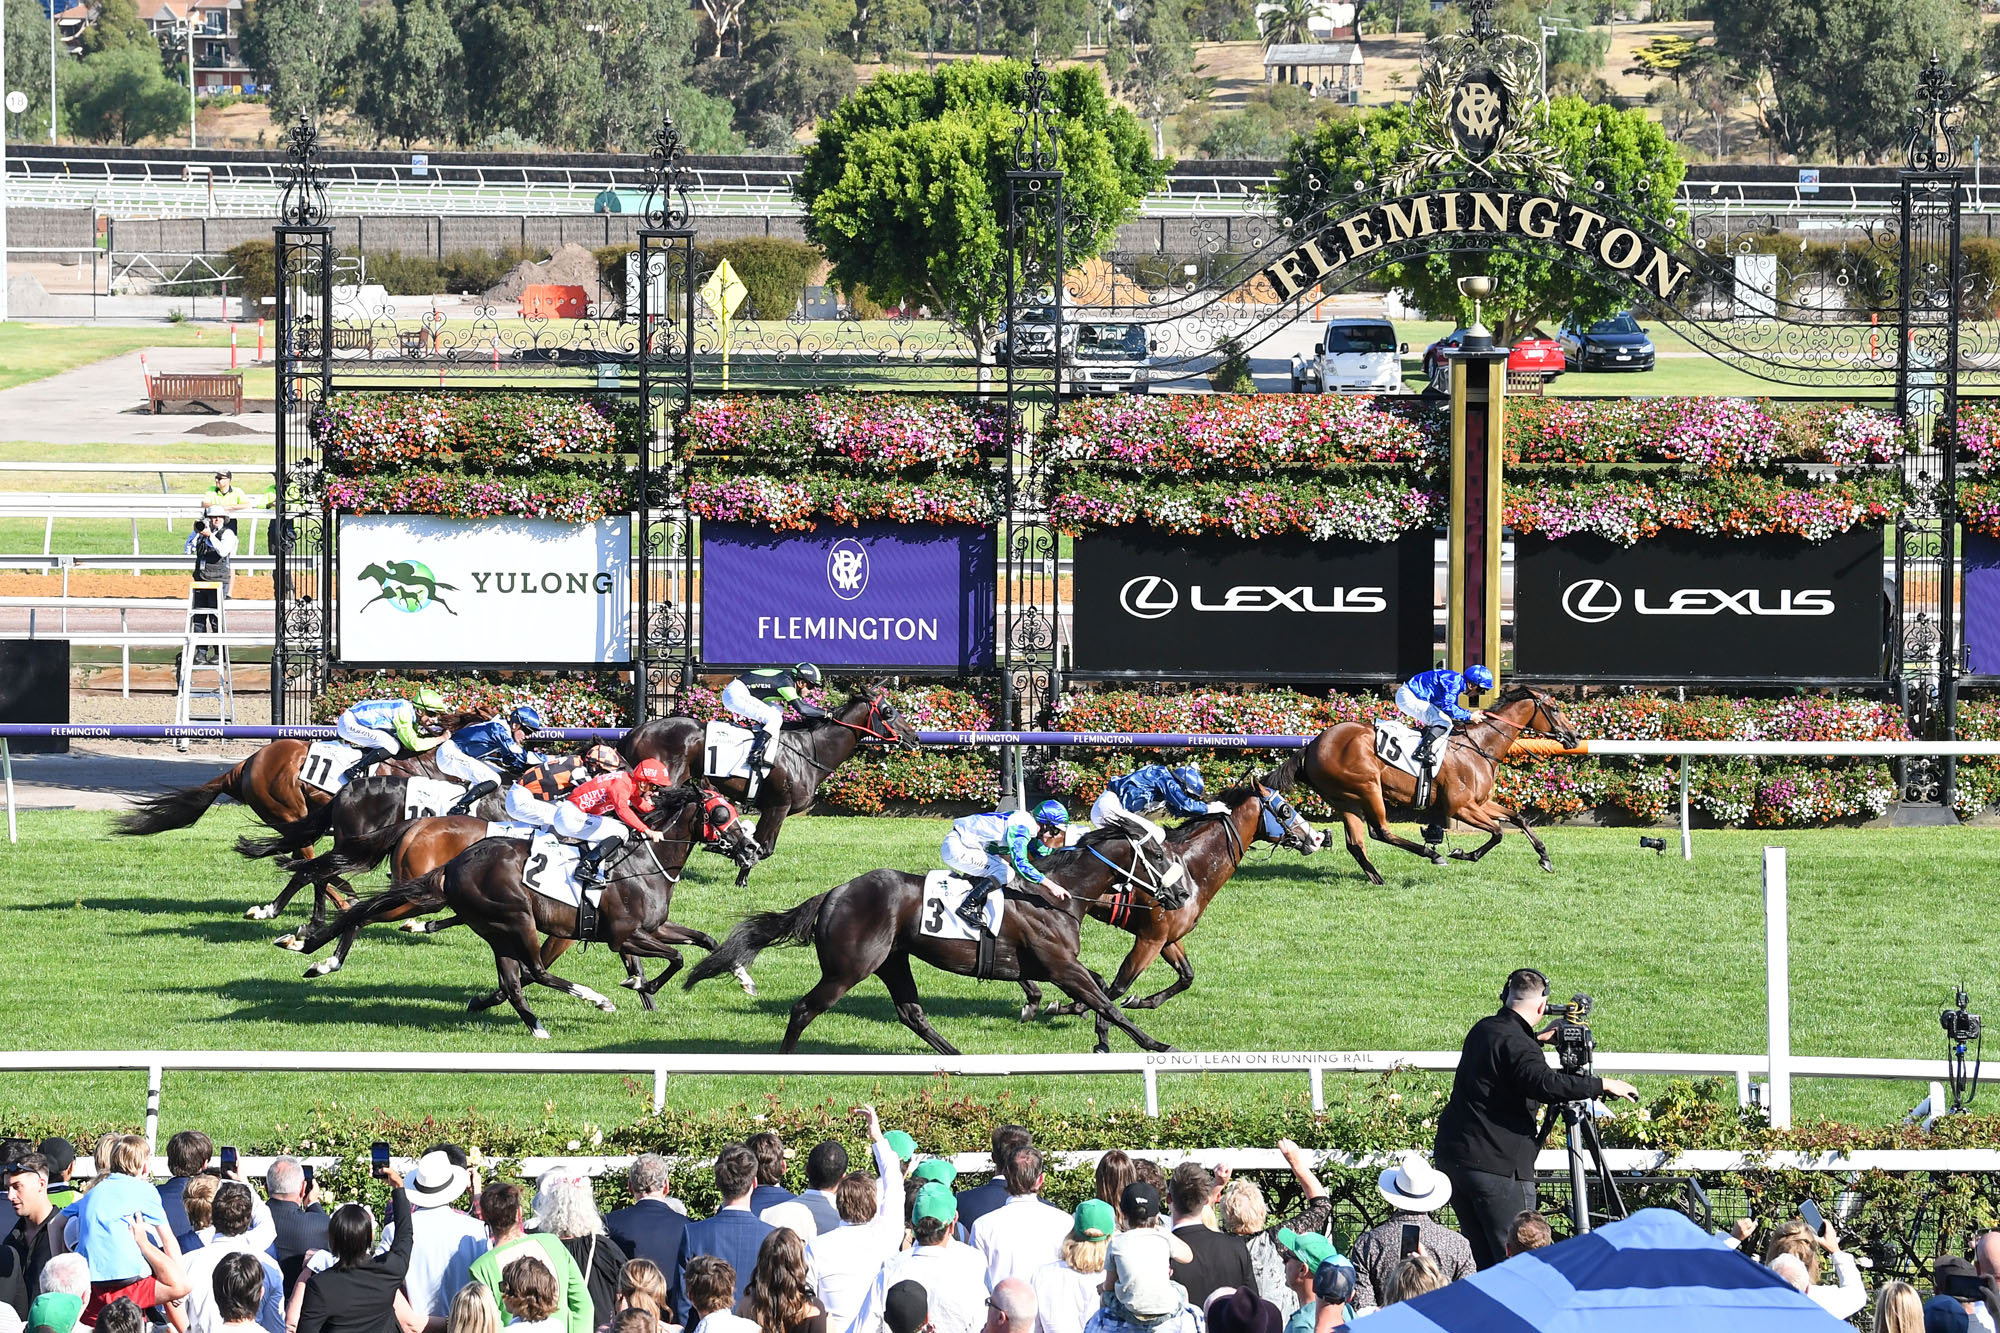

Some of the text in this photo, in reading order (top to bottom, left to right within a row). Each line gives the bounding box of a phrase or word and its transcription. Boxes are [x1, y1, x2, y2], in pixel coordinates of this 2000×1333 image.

[1267, 191, 1692, 299] FLEMINGTON
[471, 572, 613, 594] YULONG
[1190, 585, 1387, 613] LEXUS
[1634, 588, 1836, 616] LEXUS
[758, 616, 938, 641] FLEMINGTON
[51, 727, 111, 736] FLEMINGTON
[164, 728, 224, 737] FLEMINGTON
[278, 728, 338, 738] FLEMINGTON
[1073, 734, 1133, 744] FLEMINGTON
[1188, 736, 1248, 746] FLEMINGTON
[306, 754, 333, 786] 11
[708, 745, 718, 775] 1
[578, 788, 607, 803] TRIPLE
[526, 853, 548, 888] 2
[924, 897, 945, 934] 3
[1147, 1053, 1373, 1064] DO NOT LEAN ON RUNNING RAIL
